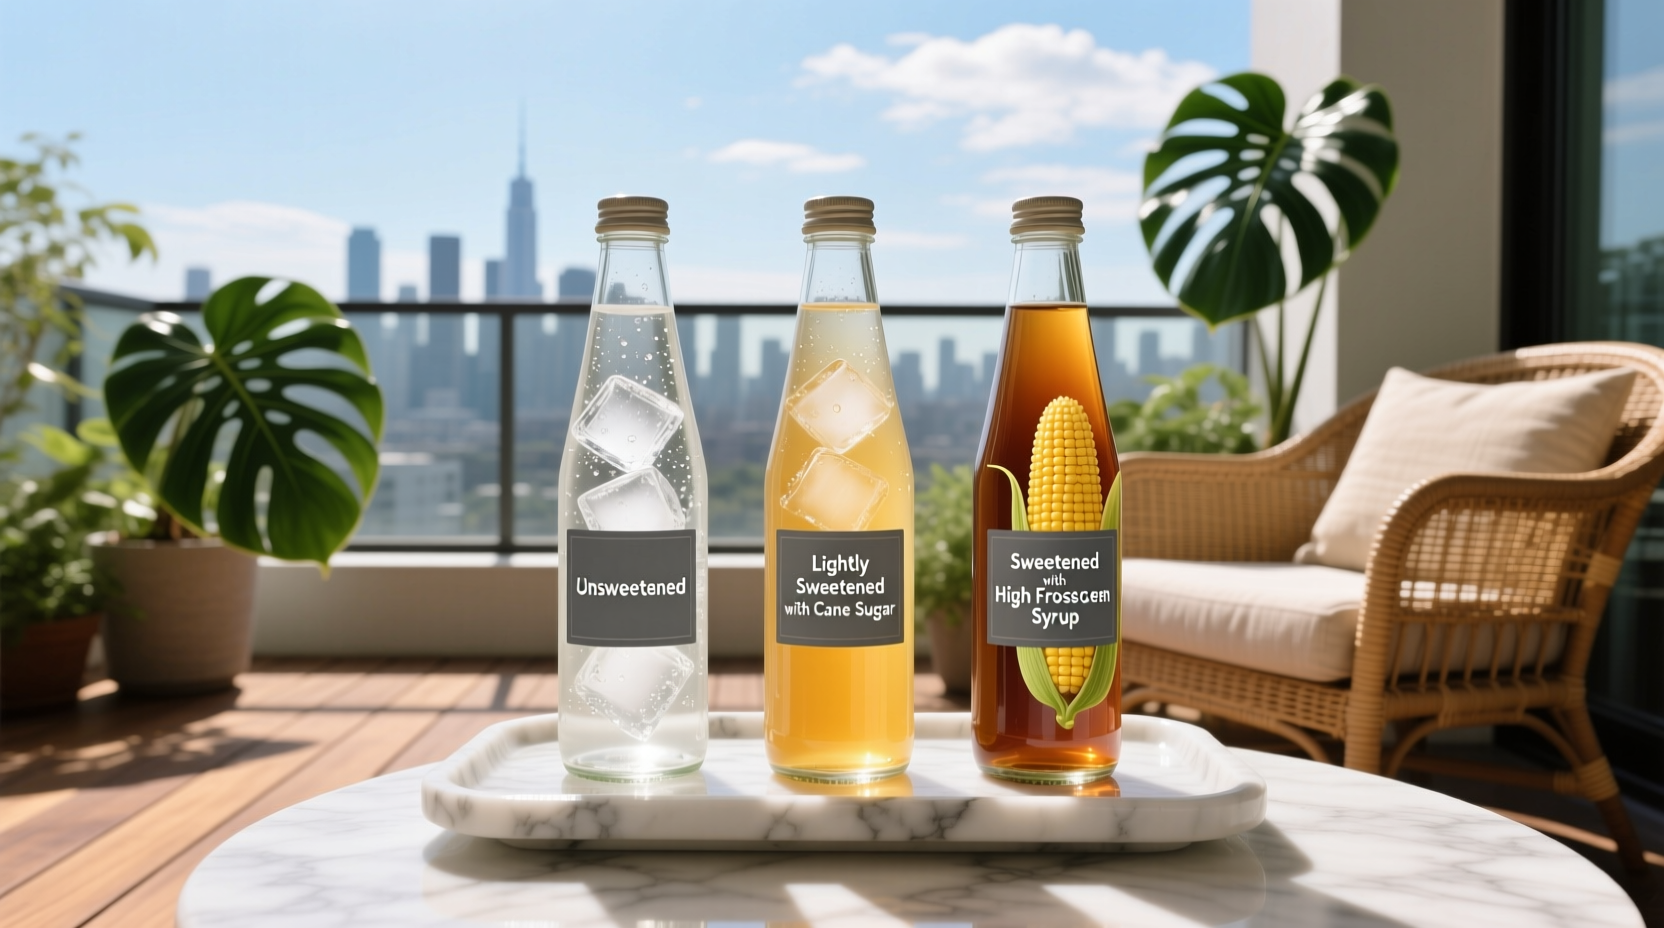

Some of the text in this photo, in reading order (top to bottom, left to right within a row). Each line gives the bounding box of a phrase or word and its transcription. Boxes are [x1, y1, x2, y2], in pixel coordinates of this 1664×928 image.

[812, 553, 870, 578] Lightly
[1010, 551, 1100, 571] Sweetened
[576, 576, 686, 597] Unsweetened
[795, 576, 885, 596] Sweetened
[1042, 572, 1067, 586] with
[995, 585, 1032, 609] High
[784, 600, 896, 622] with Cane Sugar
[1031, 606, 1080, 630] Syrup
